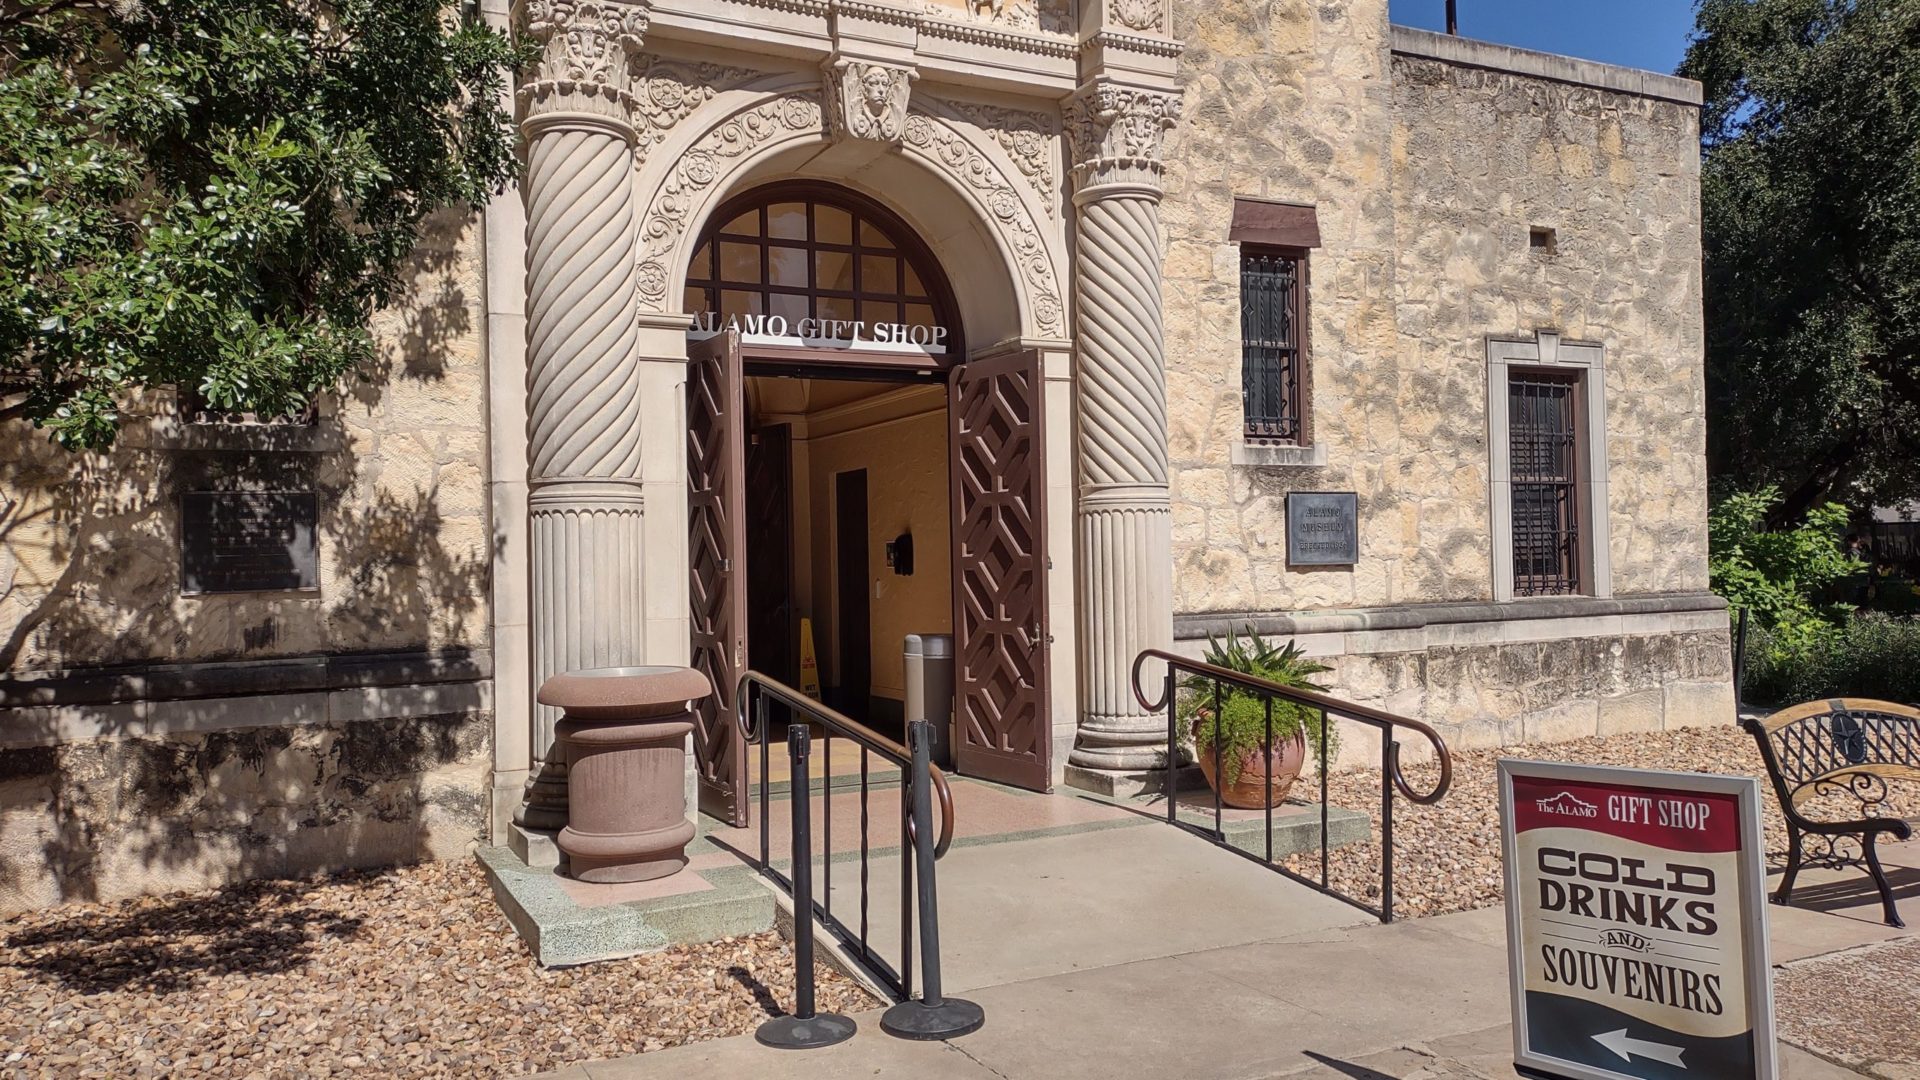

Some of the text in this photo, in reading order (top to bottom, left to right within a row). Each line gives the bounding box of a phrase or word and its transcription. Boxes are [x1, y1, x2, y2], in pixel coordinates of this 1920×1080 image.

[688, 310, 948, 346] ALAMO GIFT SHOP
[1302, 522, 1344, 533] MUSEUM
[1305, 507, 1342, 518] ALAMO
[1536, 802, 1597, 818] The ALAMO
[1608, 794, 1710, 831] GIFT SHOP
[1537, 847, 1716, 896] COLD
[1538, 878, 1719, 936] DRINKS
[1607, 931, 1645, 950] AND
[1541, 944, 1723, 1016] SOUVENIRS
